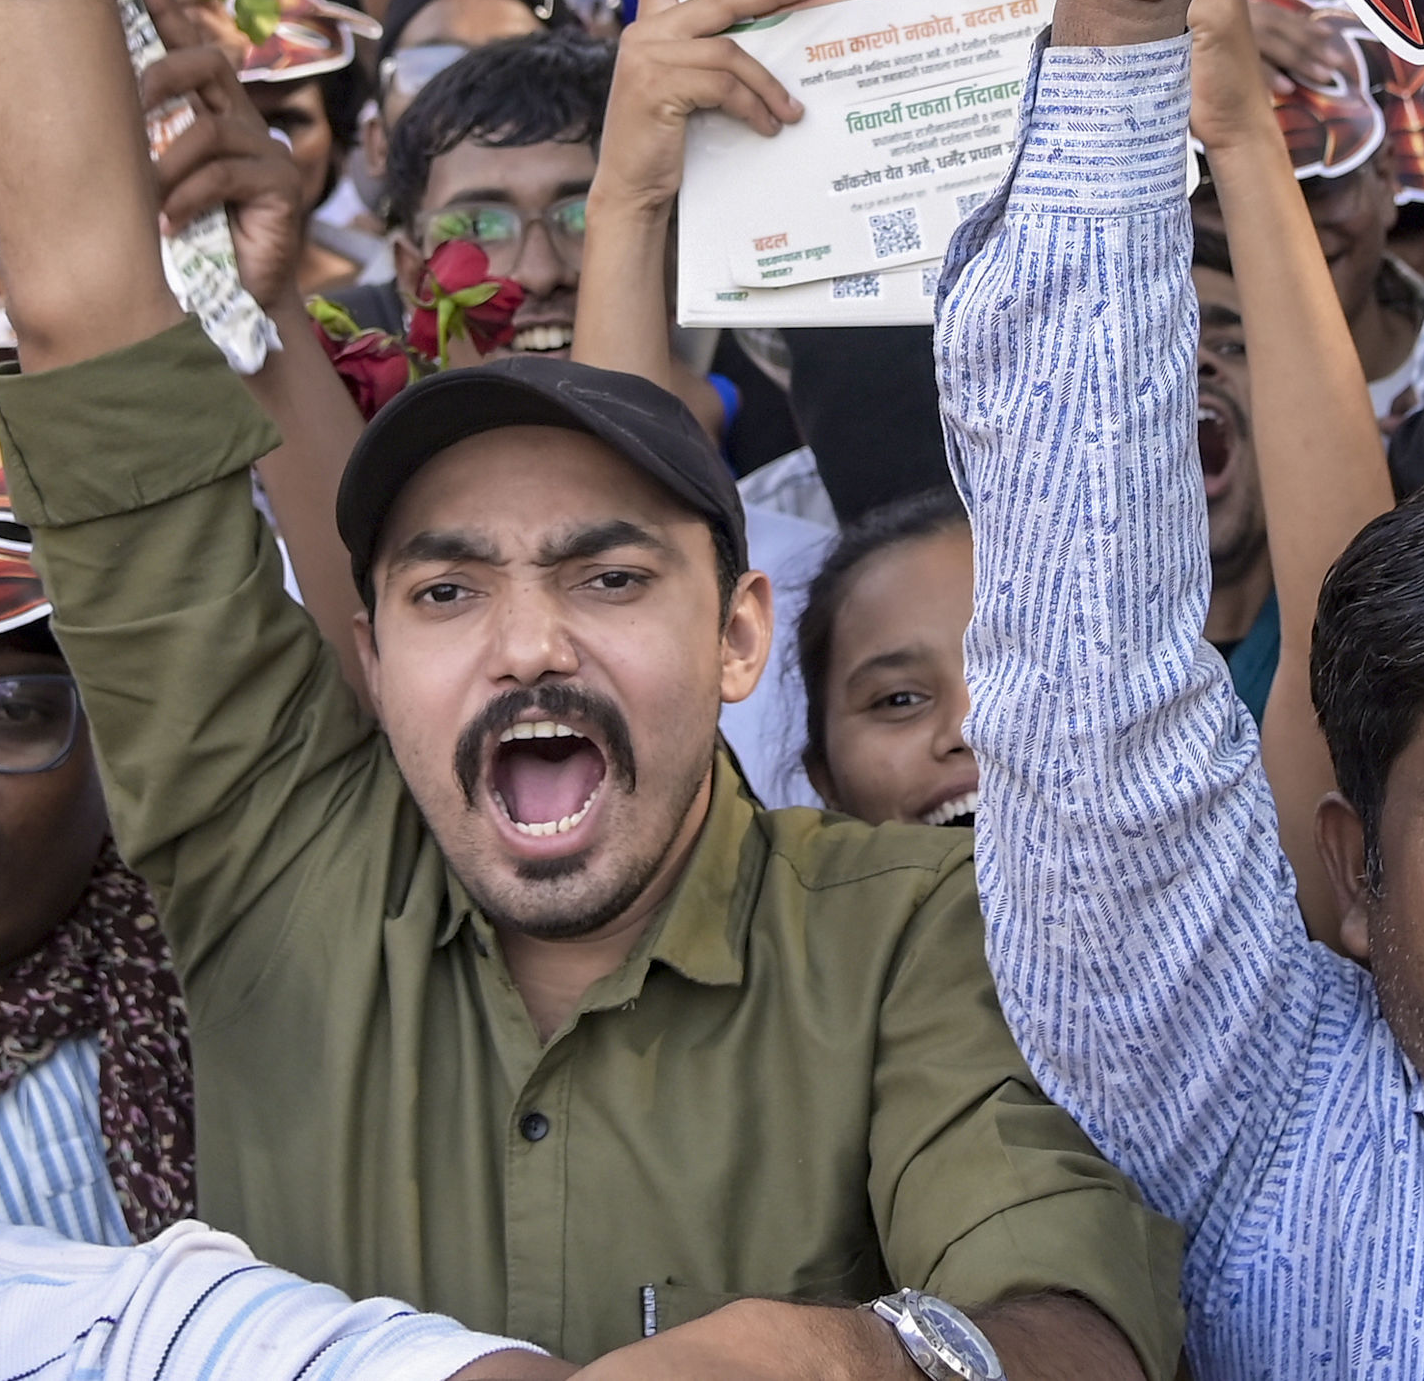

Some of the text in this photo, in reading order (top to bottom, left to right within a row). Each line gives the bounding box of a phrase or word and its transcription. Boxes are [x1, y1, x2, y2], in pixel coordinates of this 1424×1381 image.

[805, 40, 845, 63] आता
[847, 23, 899, 53] कारणे
[962, 5, 1004, 29] बदल
[846, 102, 902, 134] विद्यार्थी
[906, 96, 951, 119] एकता
[832, 169, 882, 192] कॉकरोच
[885, 164, 903, 180] येत
[907, 159, 935, 175] आहे,
[969, 143, 1002, 161] प्रधान
[752, 232, 788, 252] बदल
